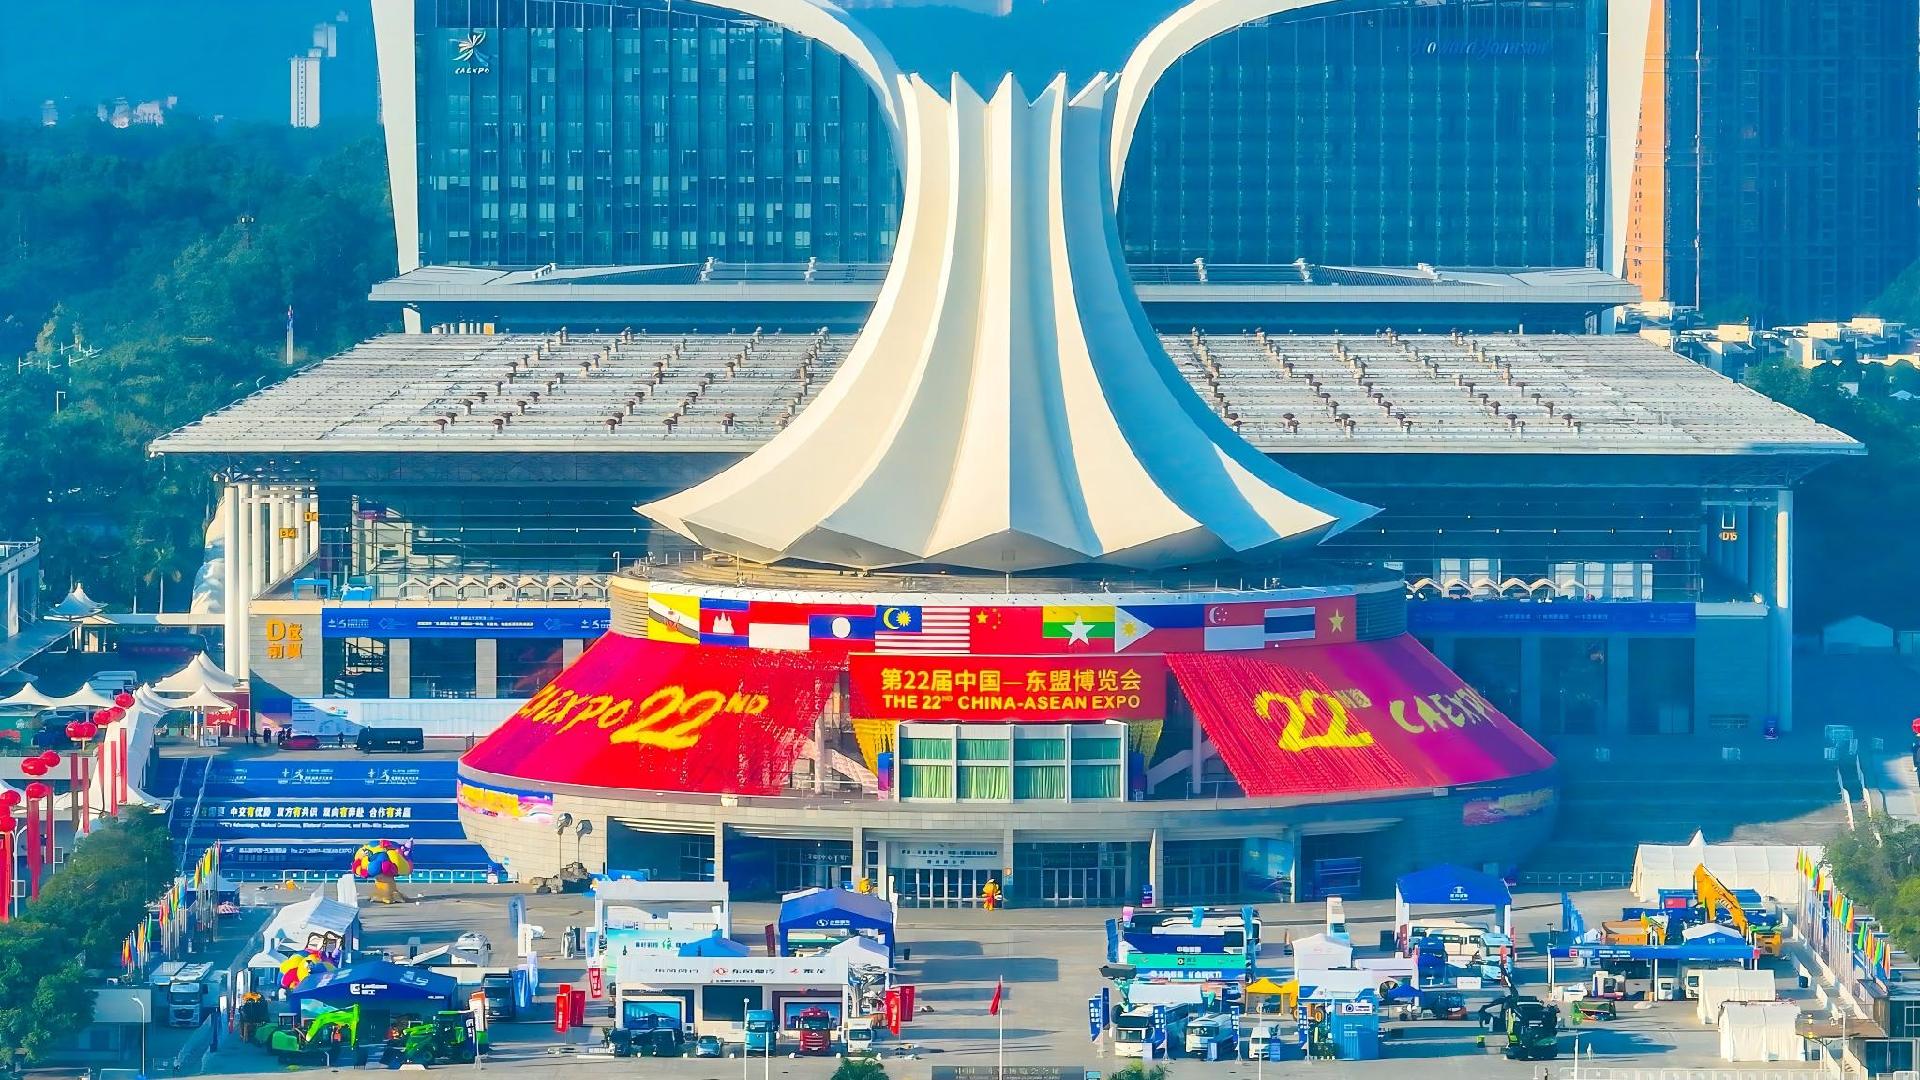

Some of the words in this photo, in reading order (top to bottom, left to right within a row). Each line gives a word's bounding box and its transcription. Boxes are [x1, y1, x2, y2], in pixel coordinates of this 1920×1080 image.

[880, 668, 1142, 693] 第22届中国—东盟博览会
[882, 695, 918, 709] THE
[957, 695, 1087, 710] CHINA-ASEAN
[1091, 695, 1141, 709] EXPO
